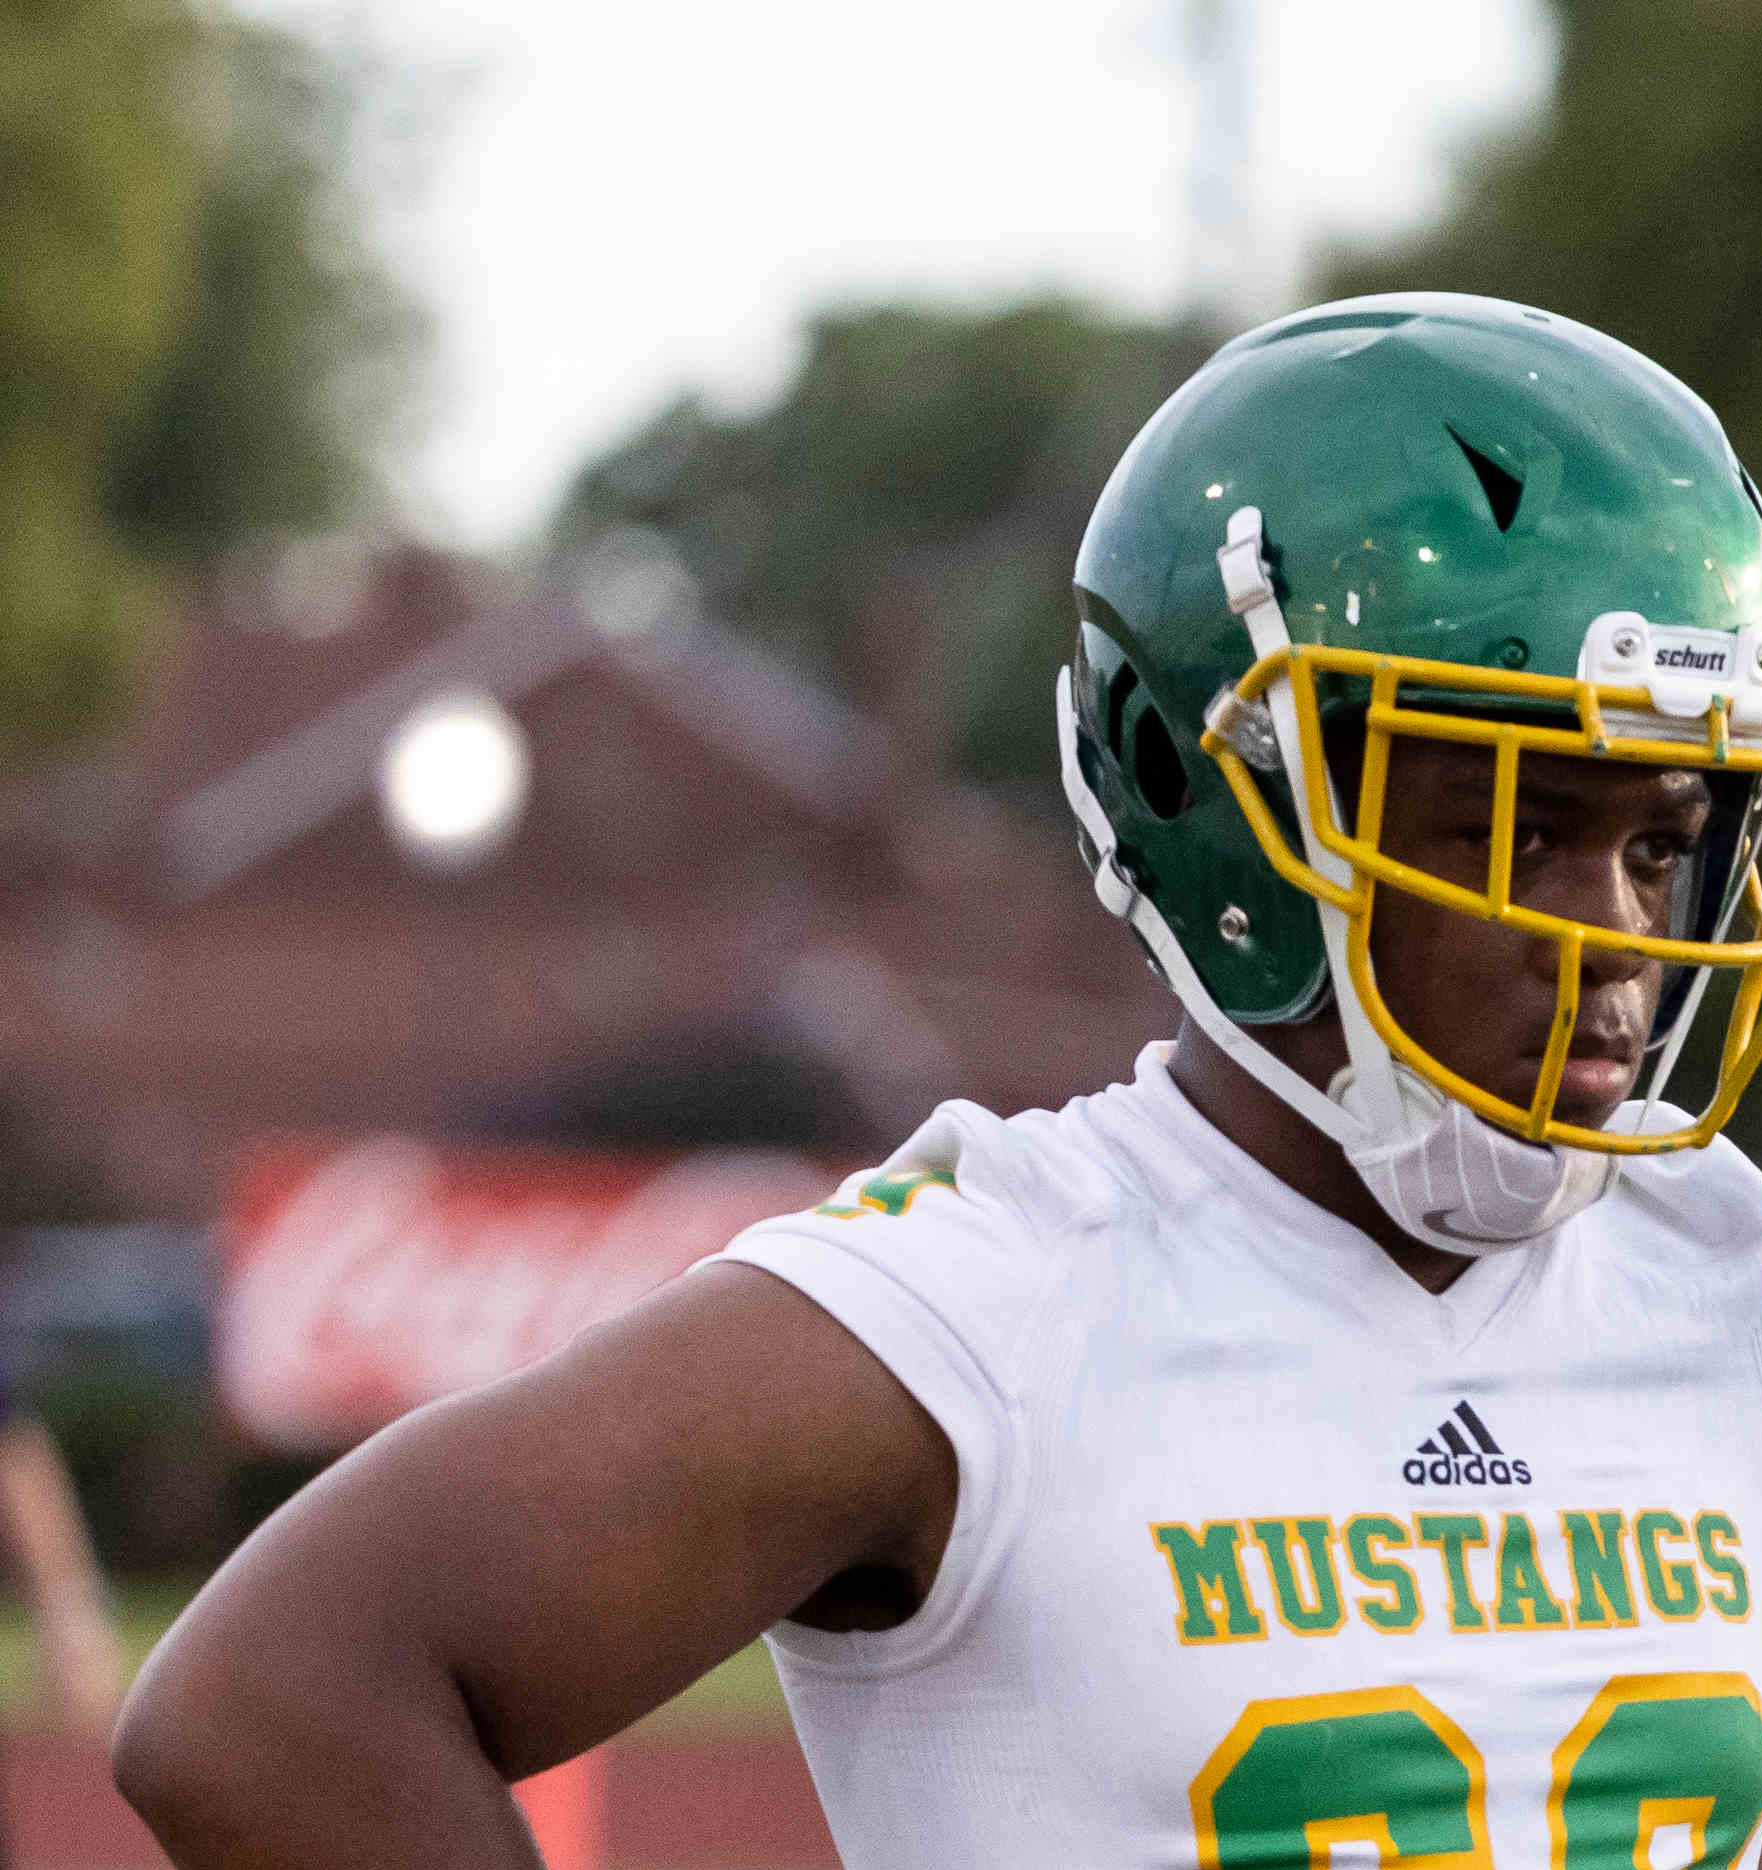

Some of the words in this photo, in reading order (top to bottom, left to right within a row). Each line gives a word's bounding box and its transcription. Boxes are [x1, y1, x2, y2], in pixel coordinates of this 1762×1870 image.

[1654, 644, 1727, 673] schutt
[1402, 1454, 1533, 1486] adidas
[1149, 1509, 1752, 1646] MUSTANGS
